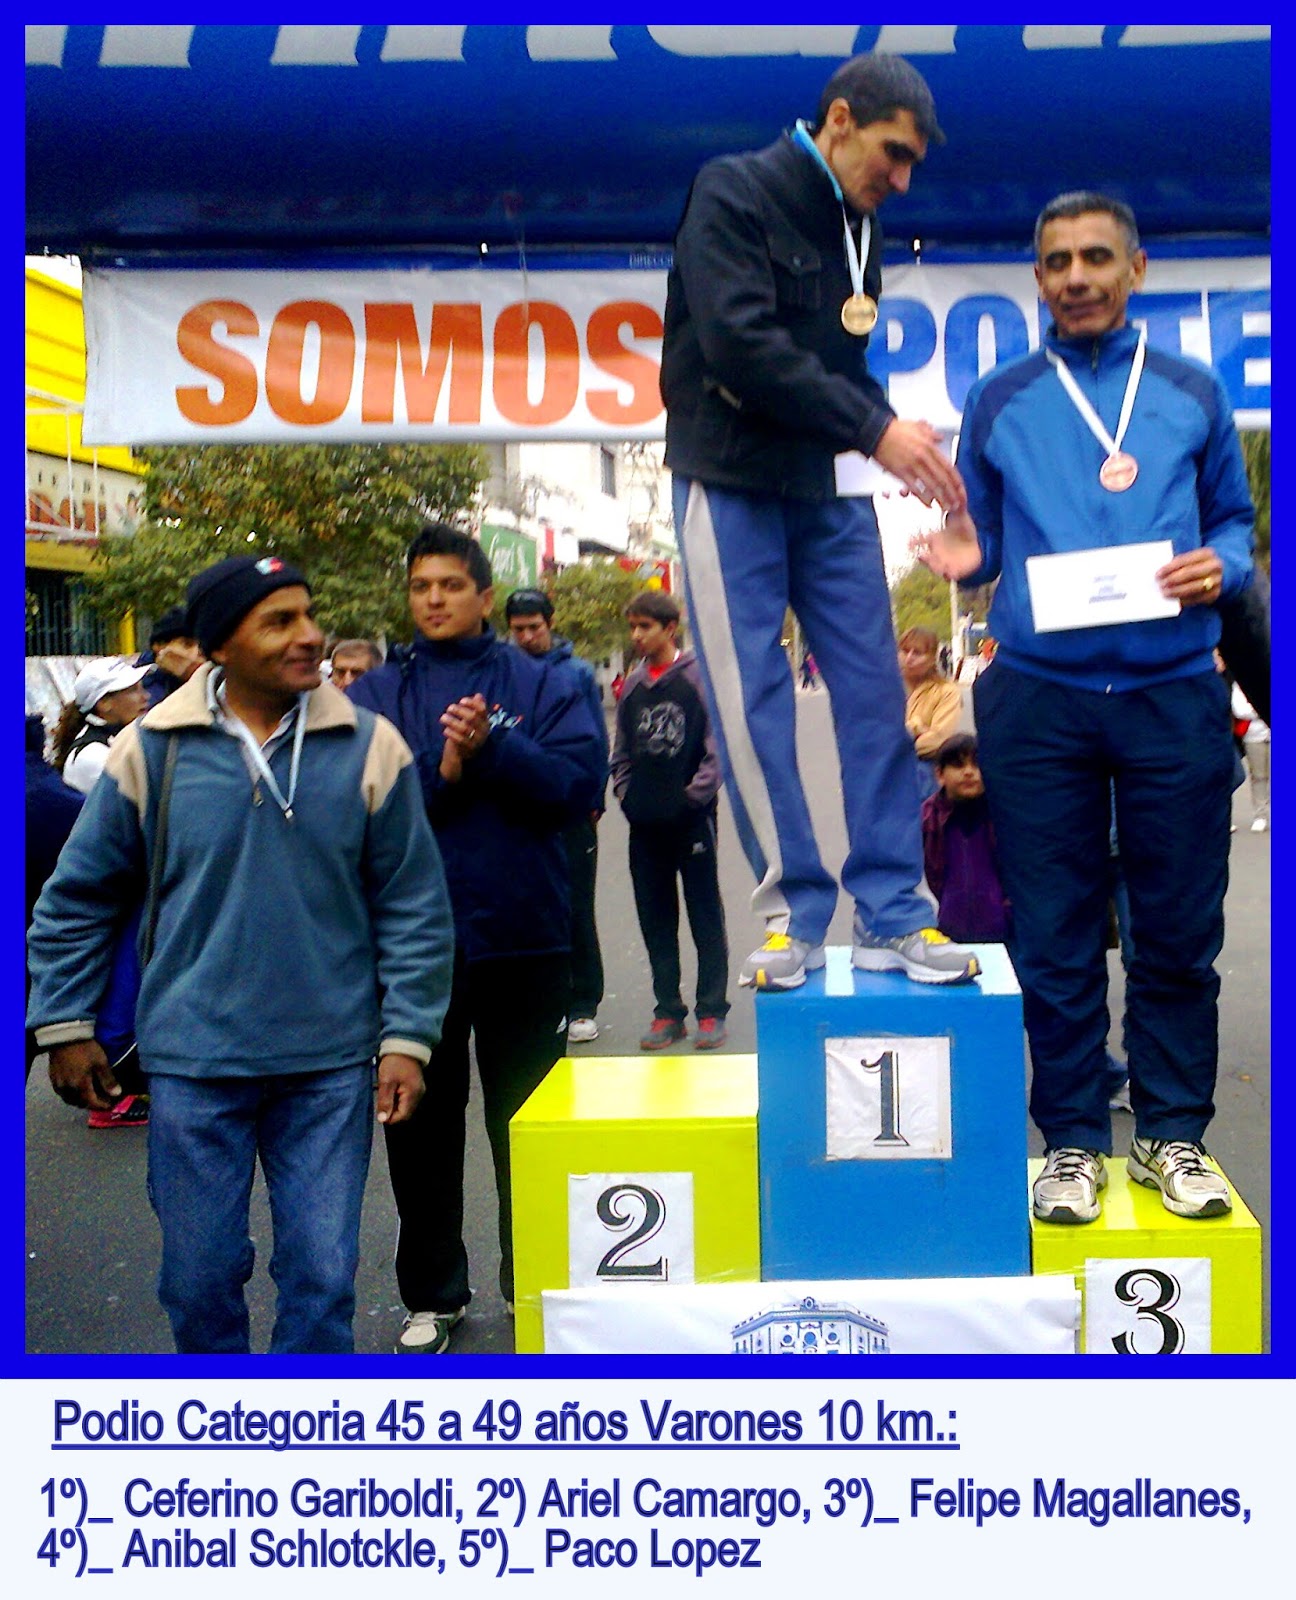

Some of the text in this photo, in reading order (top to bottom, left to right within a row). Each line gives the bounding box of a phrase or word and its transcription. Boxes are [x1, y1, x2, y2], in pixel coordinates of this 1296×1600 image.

[175, 299, 666, 426] SOMOS
[859, 1050, 910, 1148] 1
[595, 1182, 669, 1283] 2
[1111, 1268, 1186, 1354] 3
